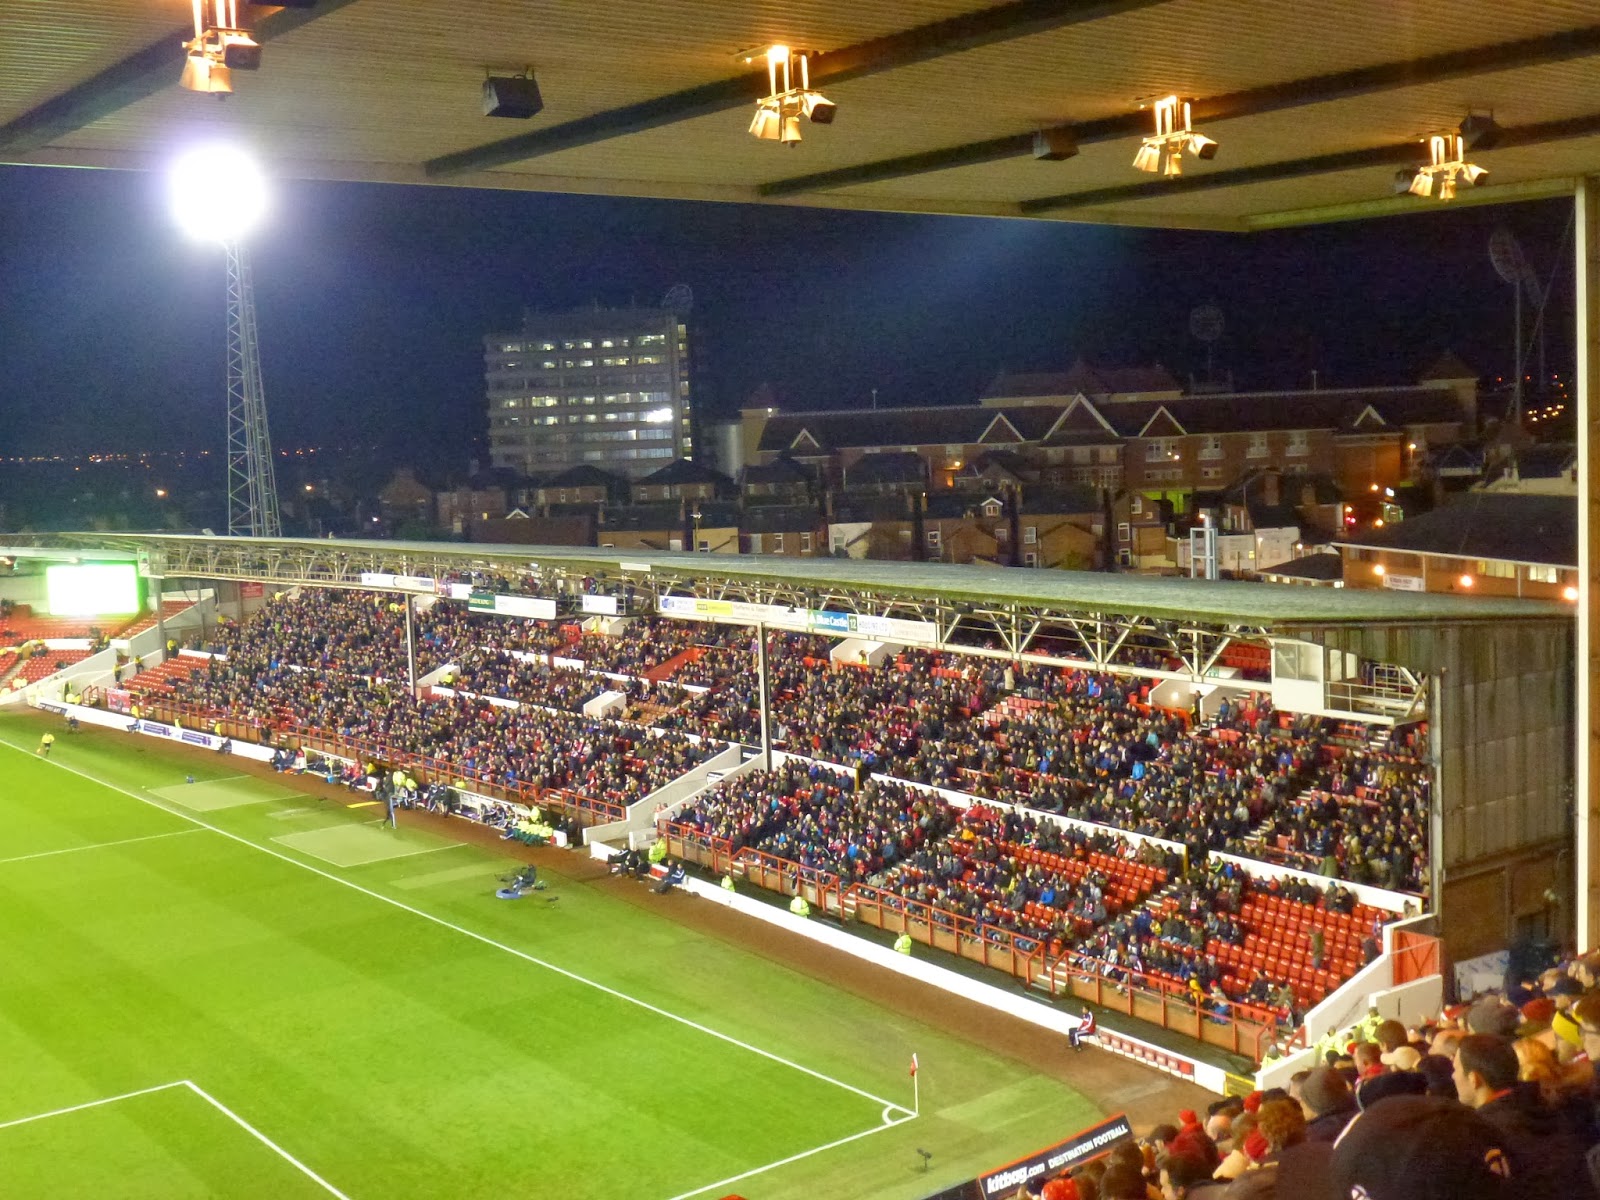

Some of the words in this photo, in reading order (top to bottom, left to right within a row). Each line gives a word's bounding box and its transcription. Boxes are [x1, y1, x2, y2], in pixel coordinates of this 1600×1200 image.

[816, 614, 830, 626] Blue
[829, 616, 848, 628] Castle
[850, 618, 857, 629] 12
[987, 1163, 1045, 1194] kitbag.com
[1048, 1138, 1094, 1169] DESTINATION
[1092, 1124, 1128, 1148] FOOTBALL
